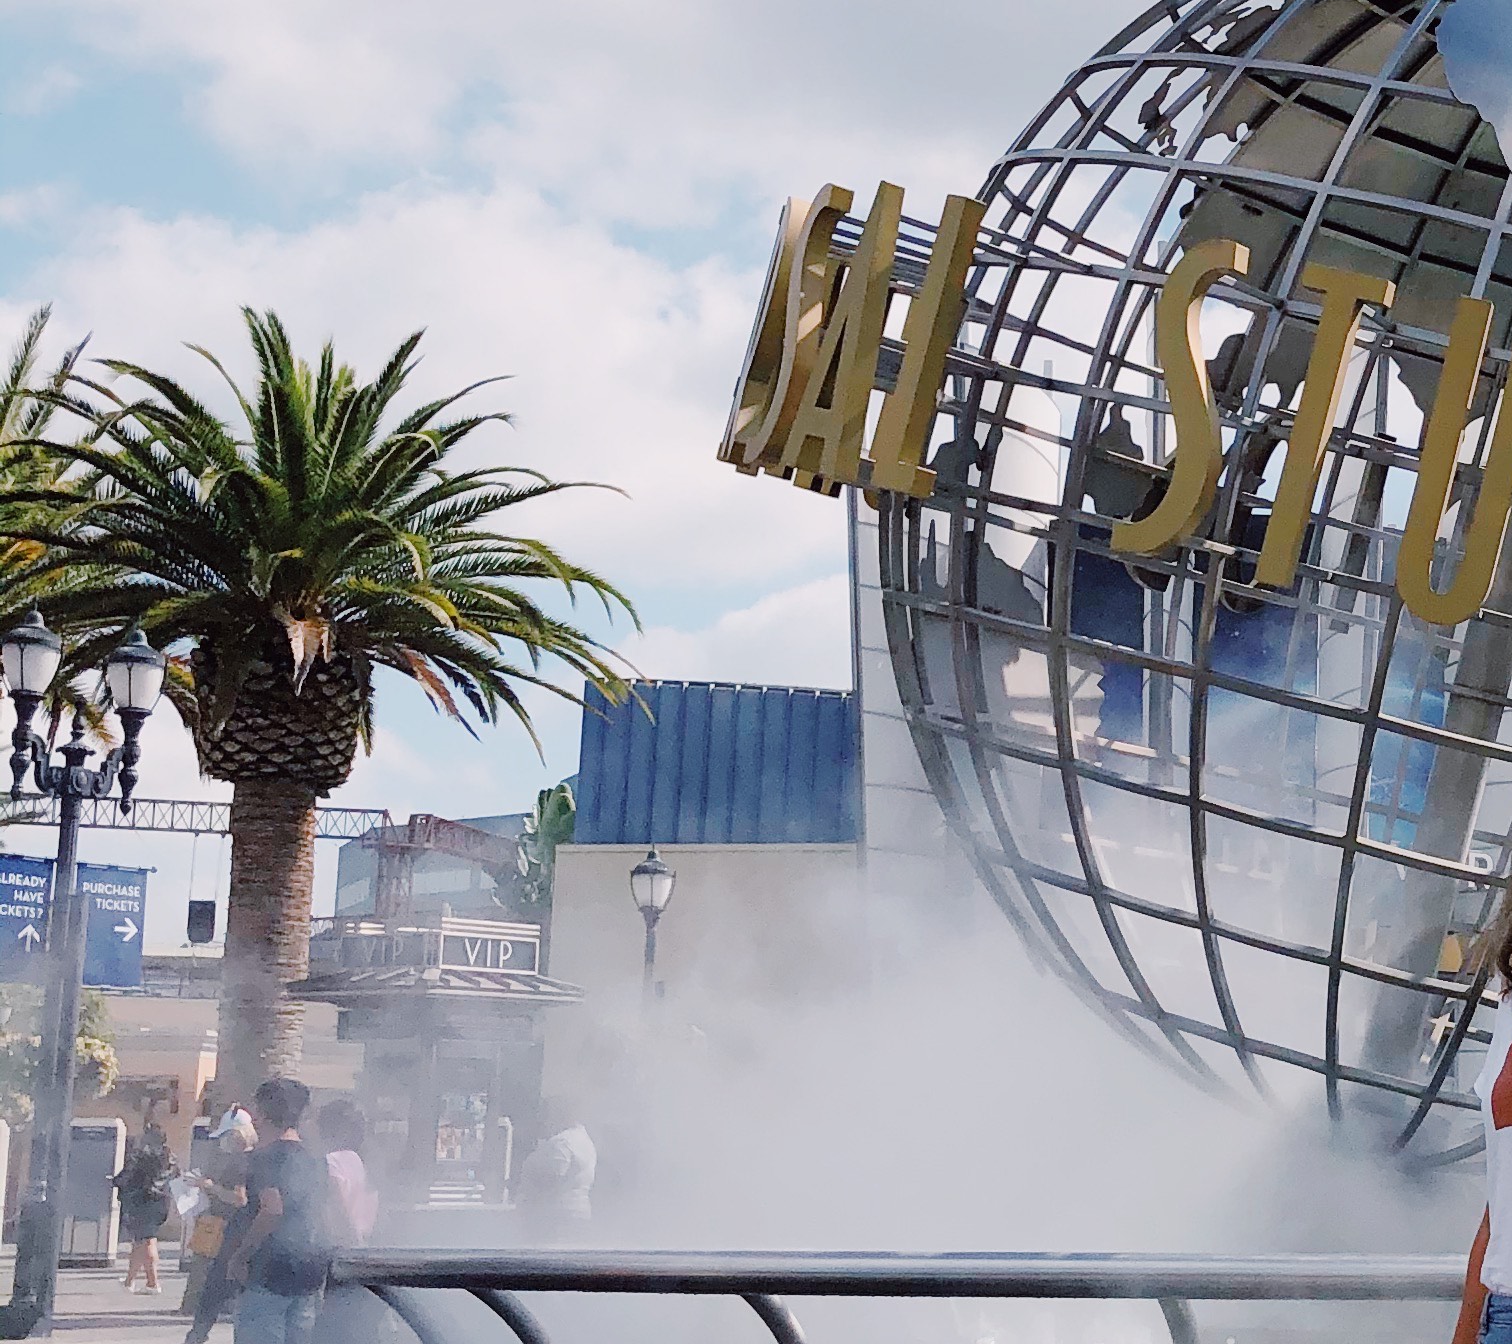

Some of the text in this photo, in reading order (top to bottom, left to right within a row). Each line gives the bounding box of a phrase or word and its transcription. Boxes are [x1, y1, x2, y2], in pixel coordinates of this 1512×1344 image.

[0, 872, 47, 888] LREADY
[14, 889, 45, 904] HAVE
[82, 882, 141, 897] PURCHASE
[0, 904, 44, 919] CKETS?
[95, 898, 140, 913] TICKETS
[464, 938, 513, 969] VIP
